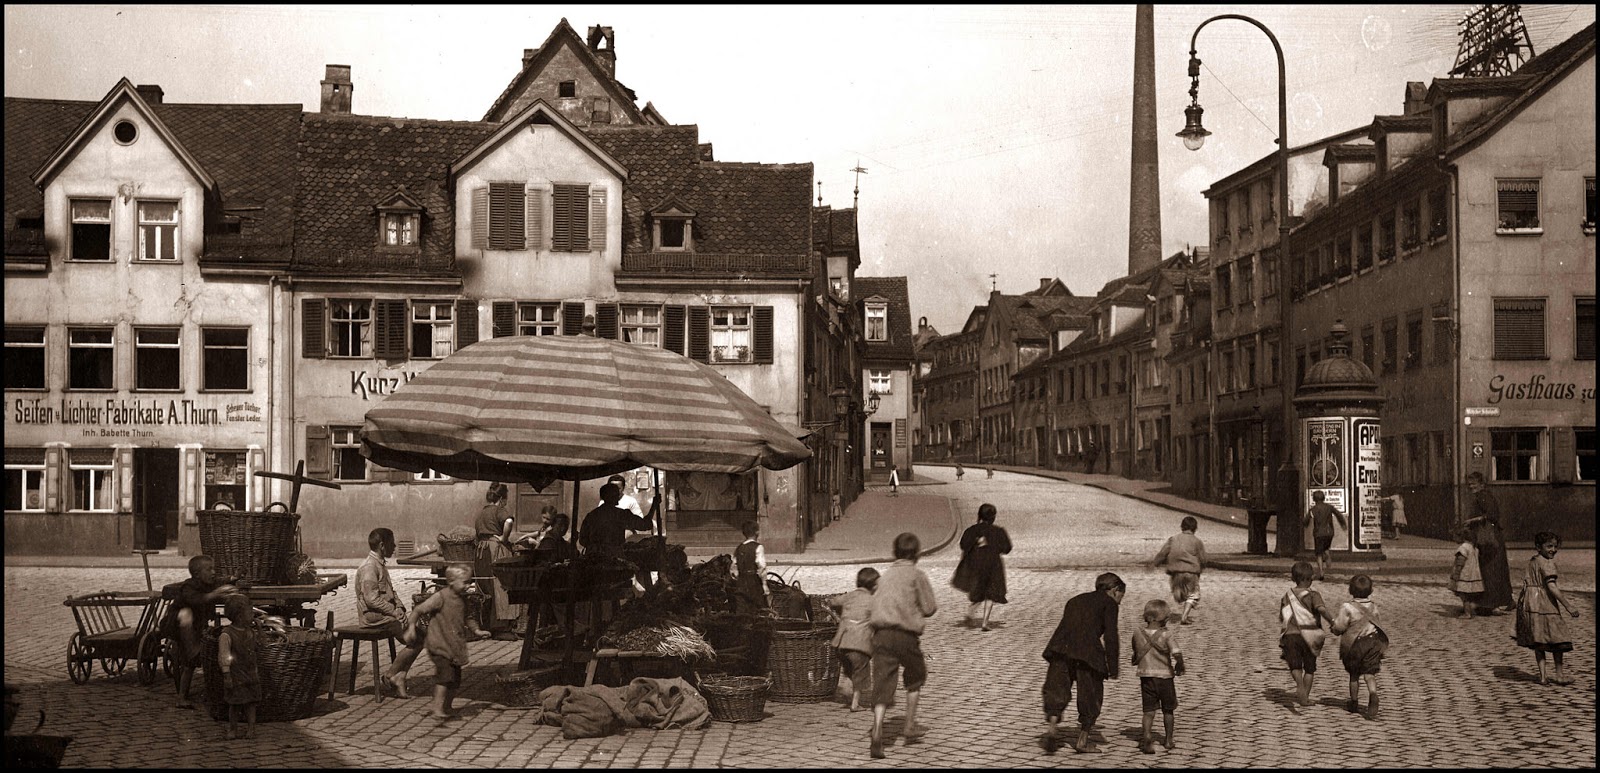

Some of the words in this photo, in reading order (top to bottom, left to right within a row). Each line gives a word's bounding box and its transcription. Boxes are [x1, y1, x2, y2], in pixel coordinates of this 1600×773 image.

[351, 371, 399, 400] Kurz
[1487, 375, 1576, 404] Gasthaus
[15, 398, 53, 424] Seifen
[100, 428, 130, 437] Babette
